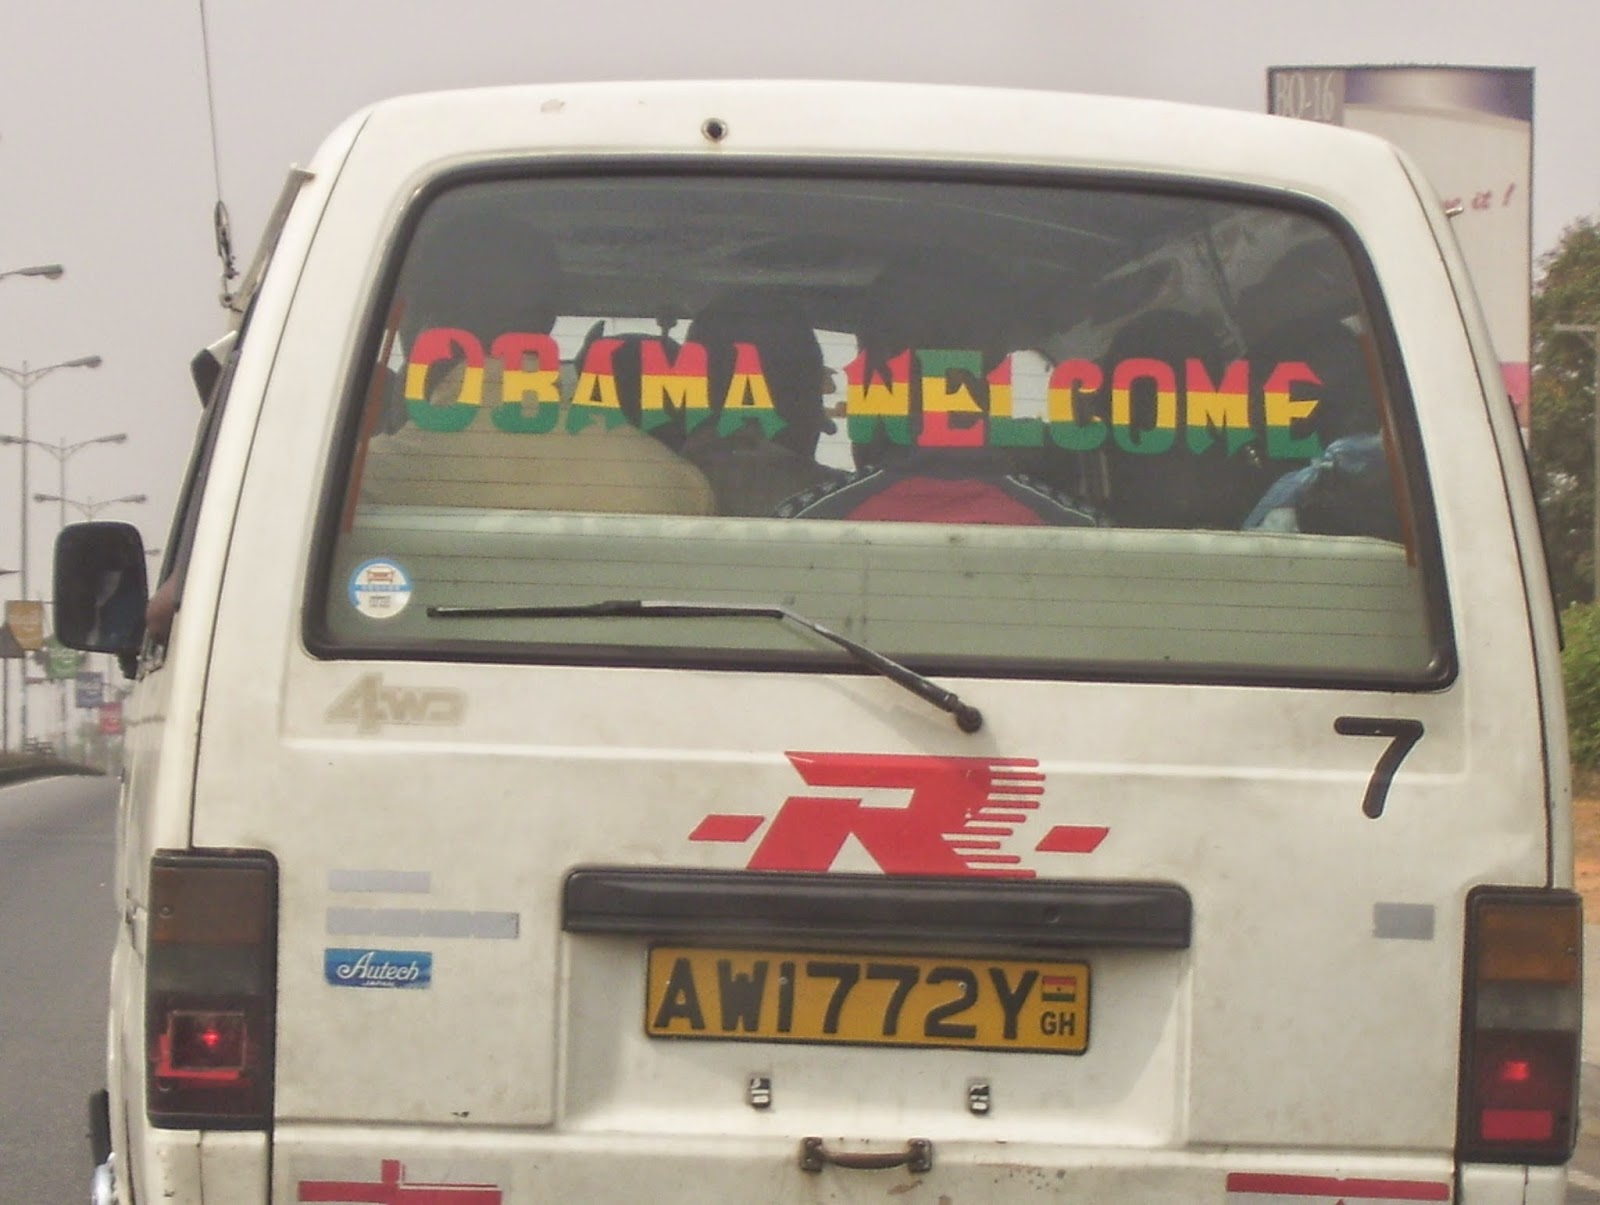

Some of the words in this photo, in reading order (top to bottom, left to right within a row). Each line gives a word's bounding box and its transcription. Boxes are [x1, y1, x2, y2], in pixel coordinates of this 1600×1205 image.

[404, 327, 789, 439] OBAMA
[842, 347, 1324, 460] WELCOME
[1334, 716, 1425, 819] 7
[336, 951, 419, 980] Autech
[1040, 1011, 1076, 1036] GH
